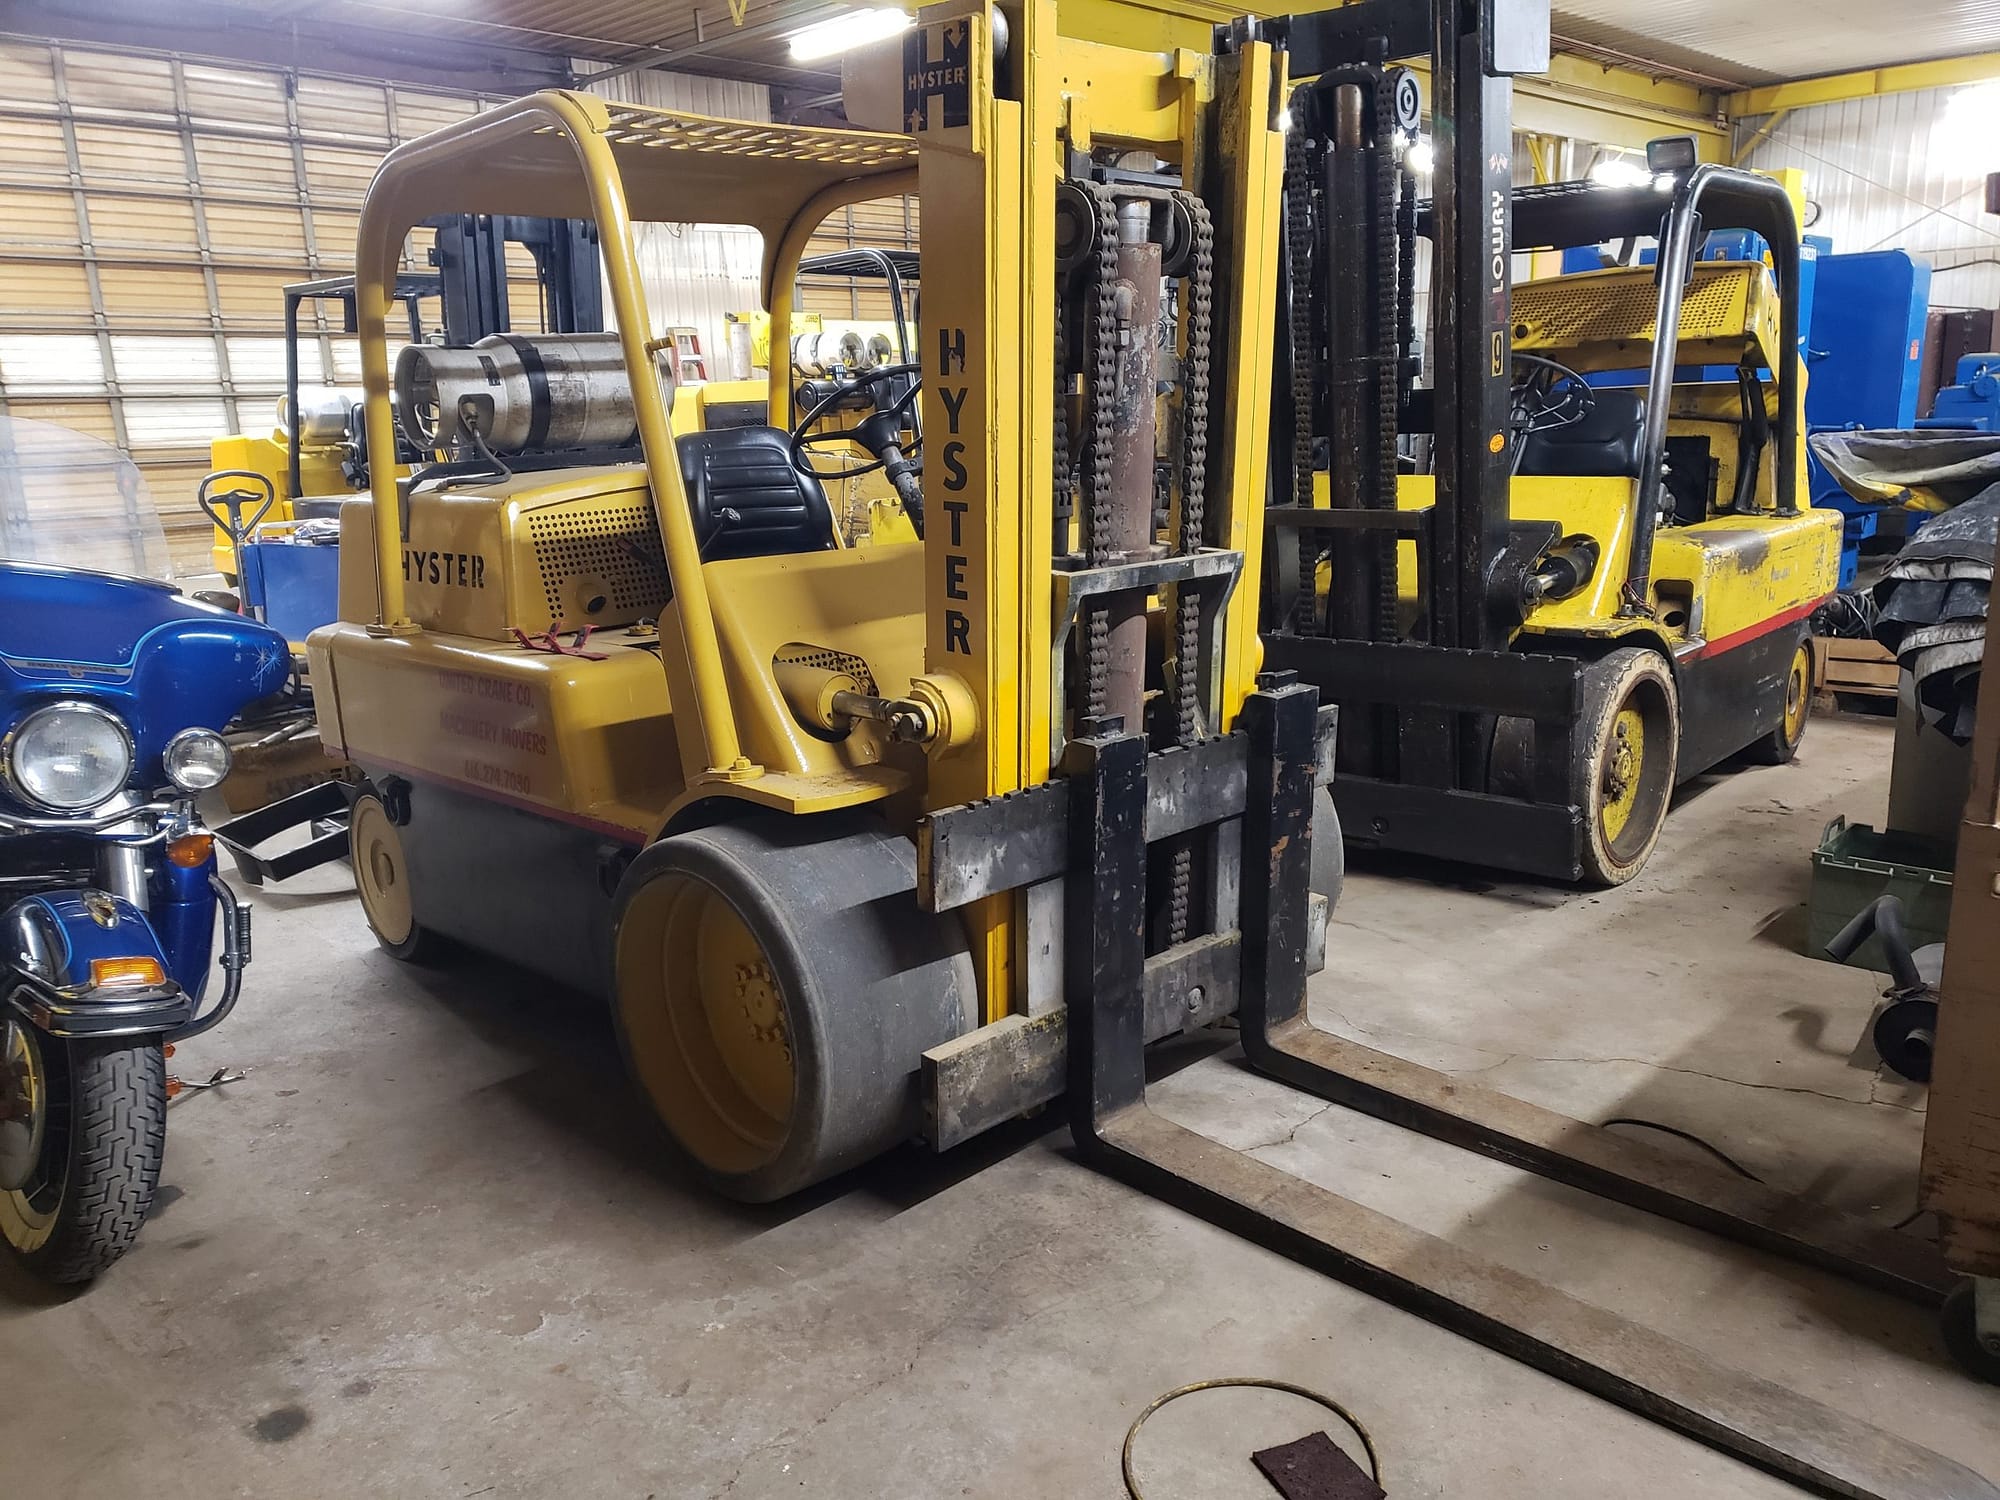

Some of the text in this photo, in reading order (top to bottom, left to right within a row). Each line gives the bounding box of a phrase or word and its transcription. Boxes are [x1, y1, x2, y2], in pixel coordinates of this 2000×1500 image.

[908, 67, 967, 91] HYSTER
[1492, 190, 1504, 293] LOWRY
[939, 328, 971, 656] HYSTER
[402, 551, 484, 588] HYSTER
[439, 671, 473, 695] UNITED
[477, 676, 513, 702] CRANE
[502, 727, 547, 755] MOVERS
